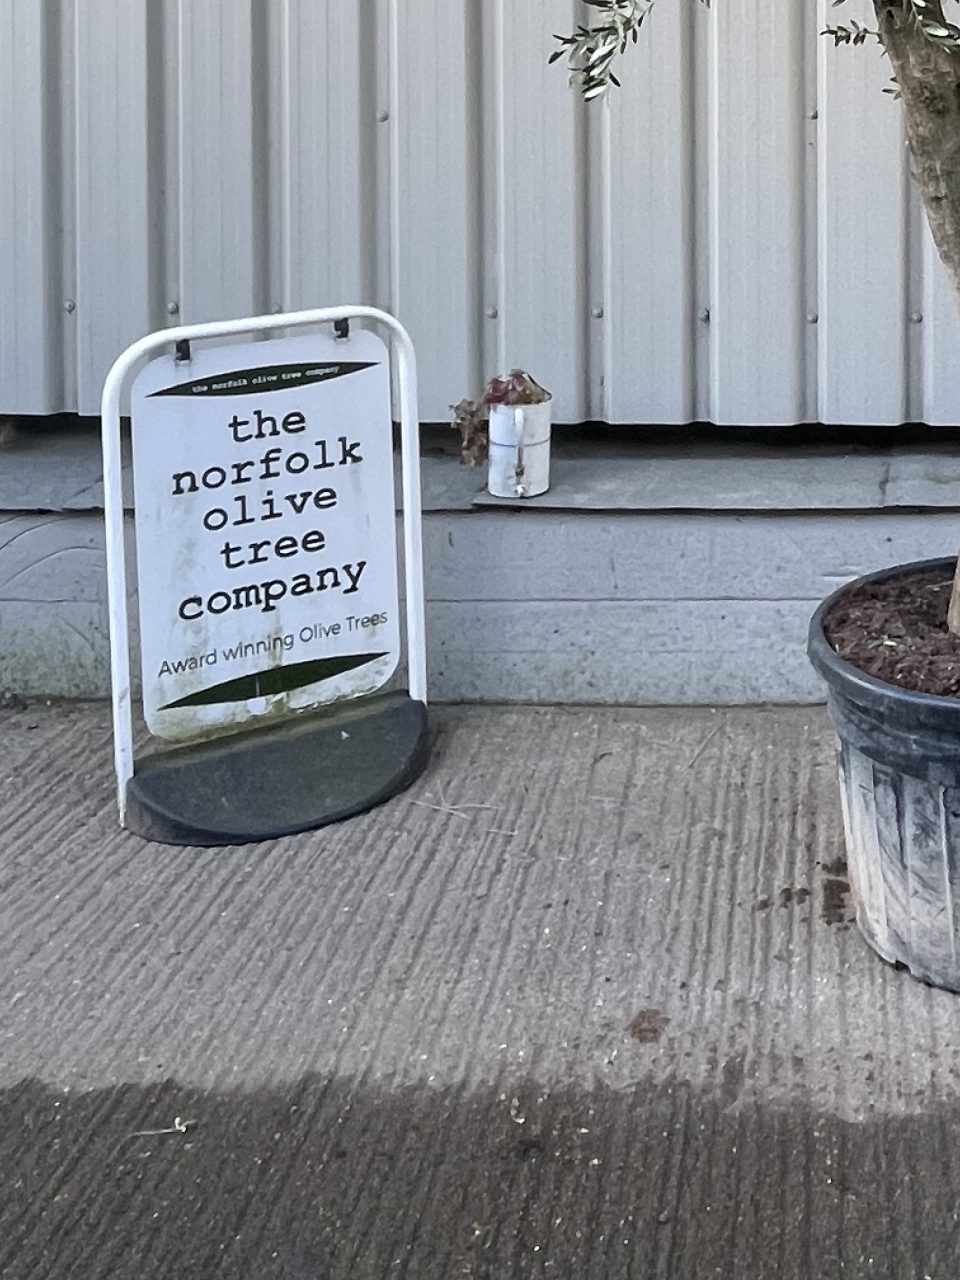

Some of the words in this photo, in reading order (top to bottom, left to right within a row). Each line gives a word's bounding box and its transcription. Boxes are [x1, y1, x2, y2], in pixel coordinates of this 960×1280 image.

[228, 410, 306, 442] the
[172, 437, 364, 495] norfolk
[204, 488, 337, 531] olive
[220, 531, 326, 569] tree
[178, 561, 367, 620] company
[158, 649, 217, 677] Award
[222, 633, 294, 661] winning
[299, 622, 341, 643] Olive
[346, 611, 388, 632] Trees
